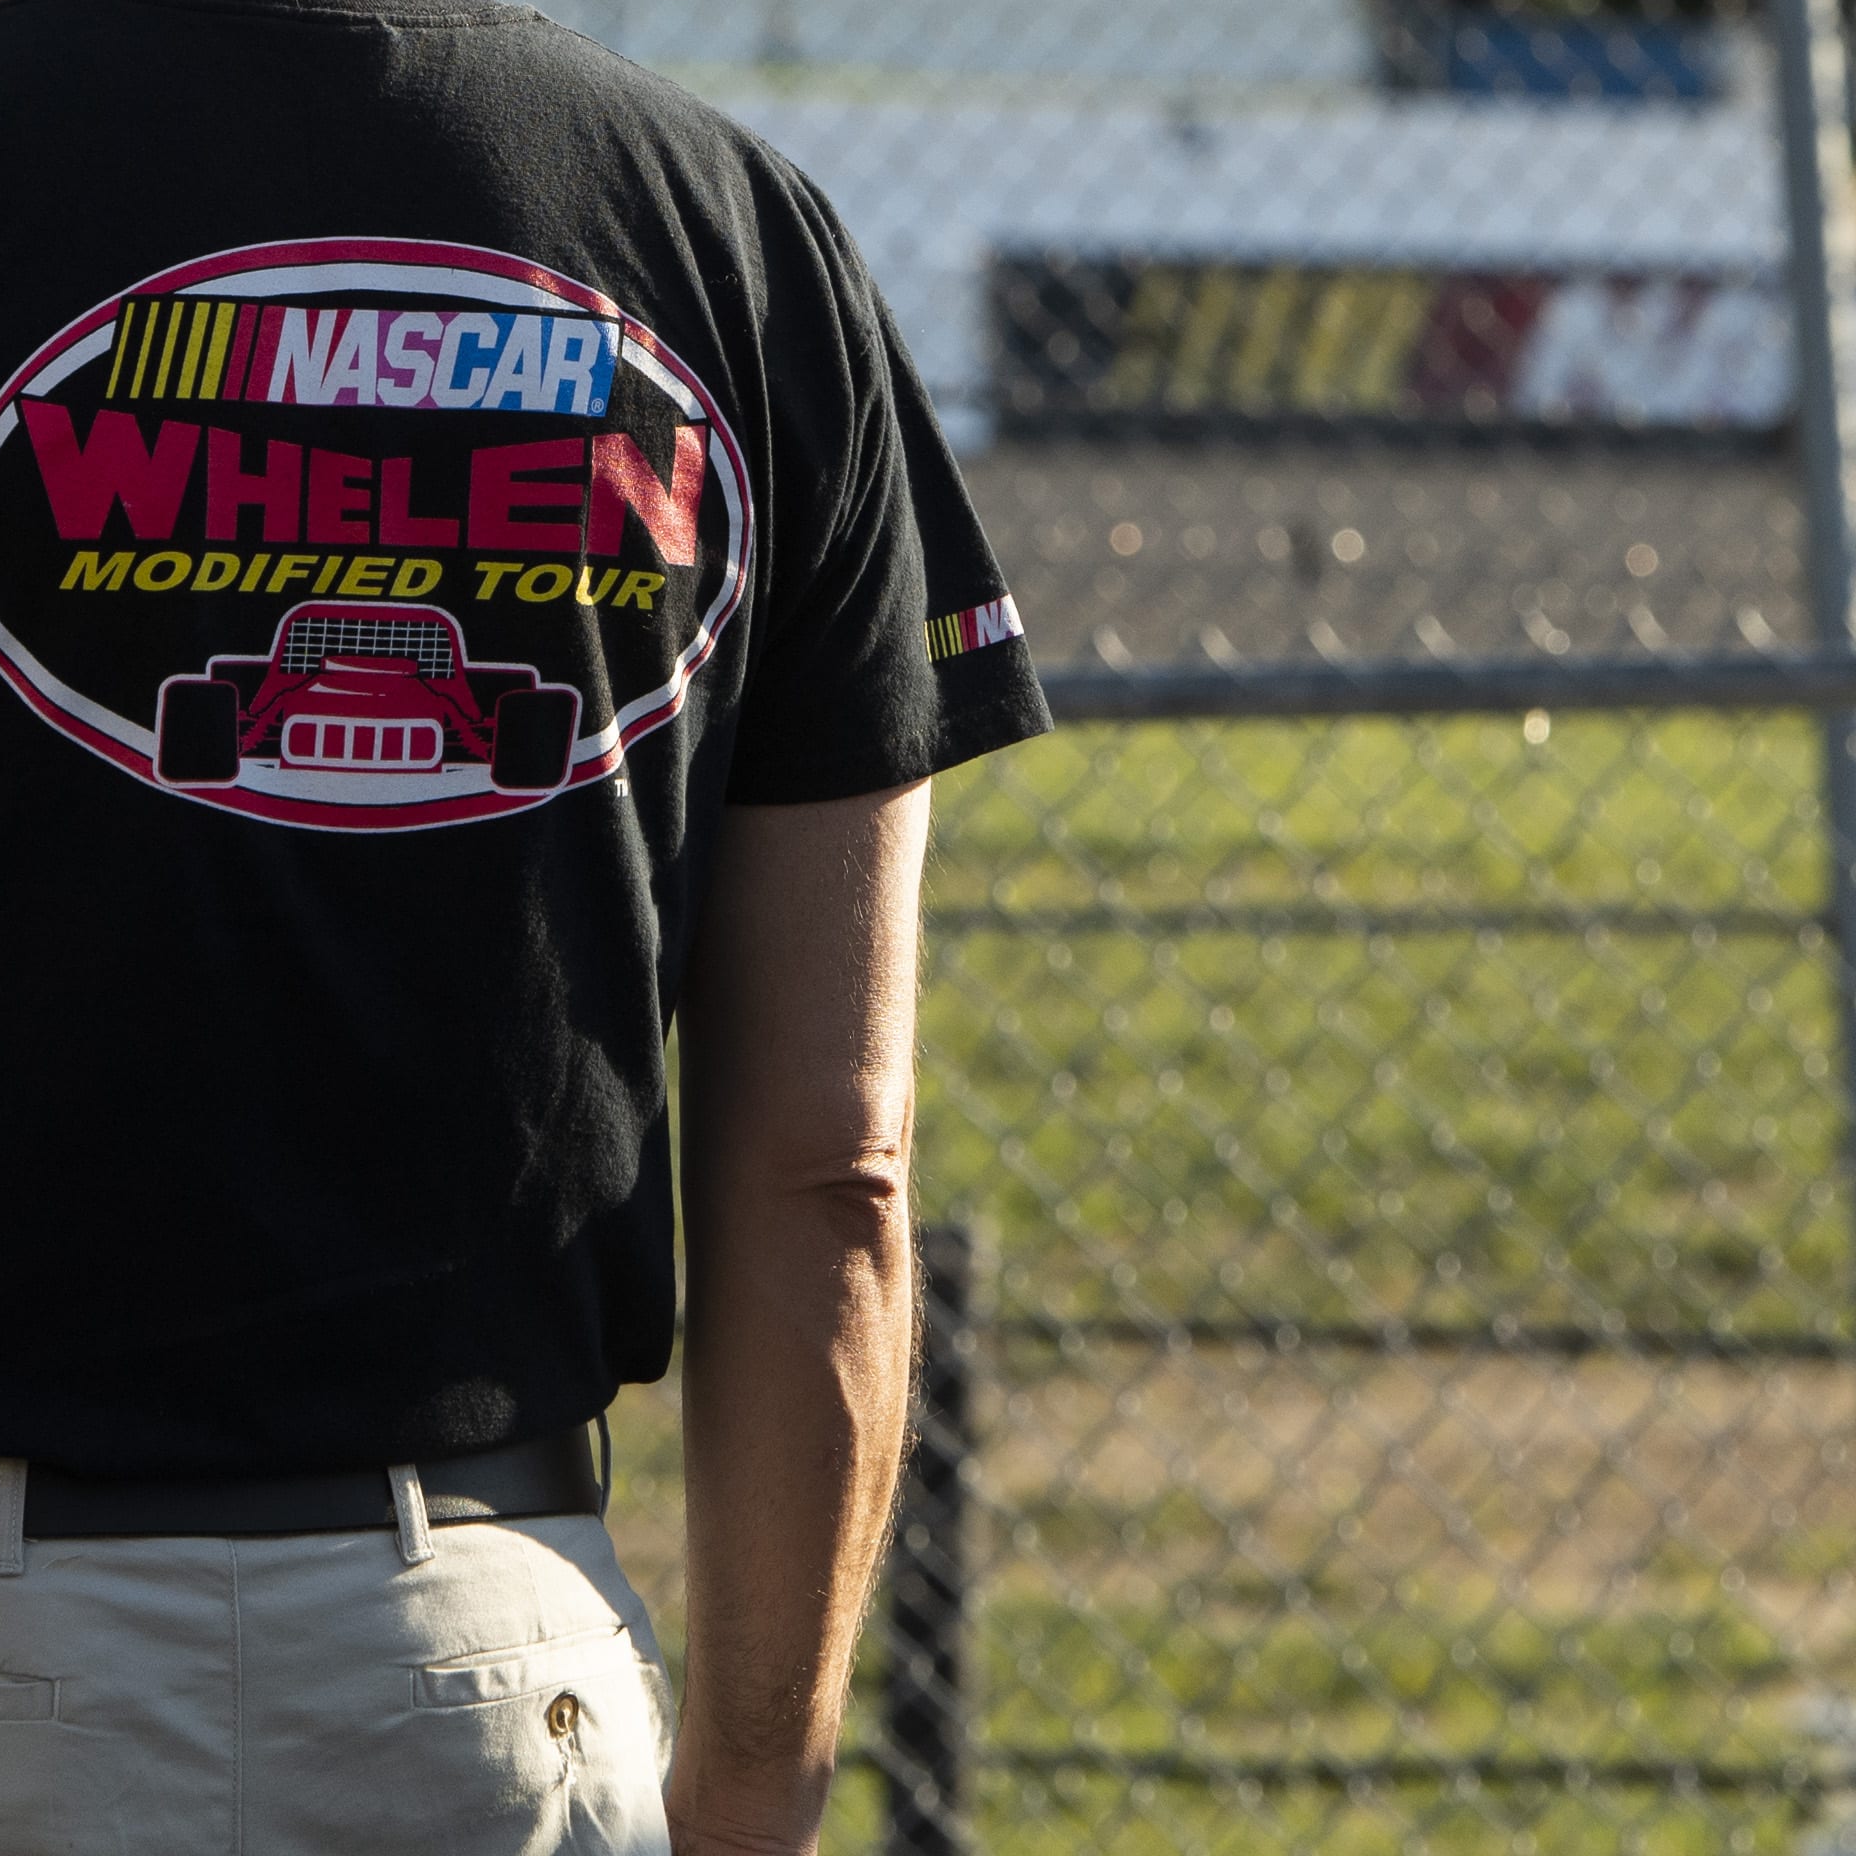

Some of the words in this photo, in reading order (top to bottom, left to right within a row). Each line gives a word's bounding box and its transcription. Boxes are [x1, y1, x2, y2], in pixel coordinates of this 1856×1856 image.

[267, 307, 602, 416] NASCAR
[20, 398, 707, 567] WHELEN
[59, 550, 442, 598] MODIFIED
[474, 562, 666, 611] TOUR
